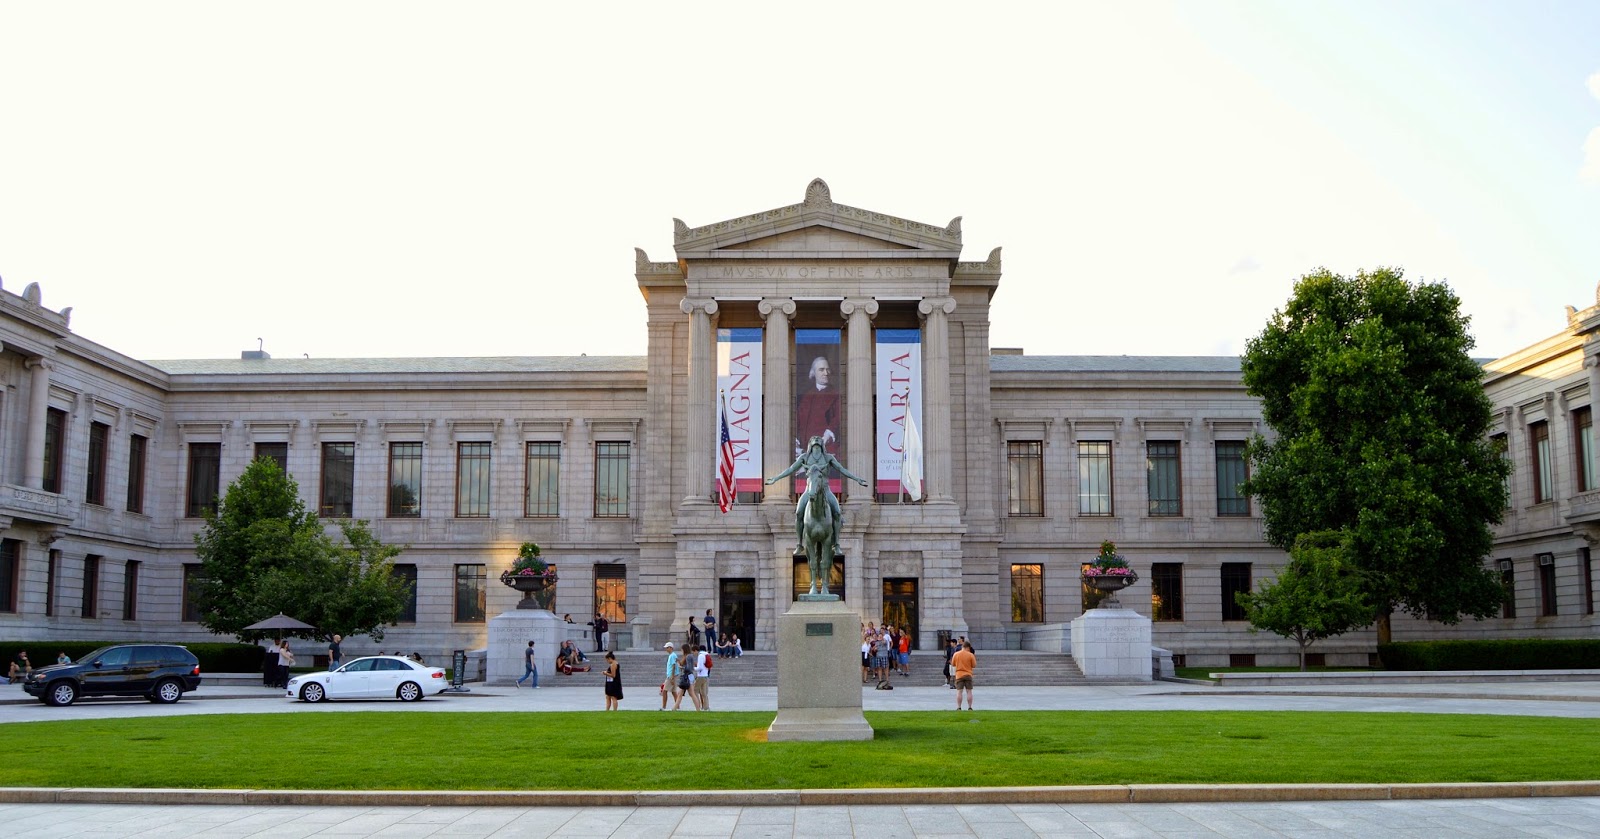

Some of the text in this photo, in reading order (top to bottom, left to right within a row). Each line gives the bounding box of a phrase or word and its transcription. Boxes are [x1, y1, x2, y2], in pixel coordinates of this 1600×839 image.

[798, 266, 817, 278] OF
[827, 266, 865, 278] FINE
[873, 266, 913, 278] ARTS
[730, 351, 751, 464] MAGNA
[887, 352, 910, 453] CARTA
